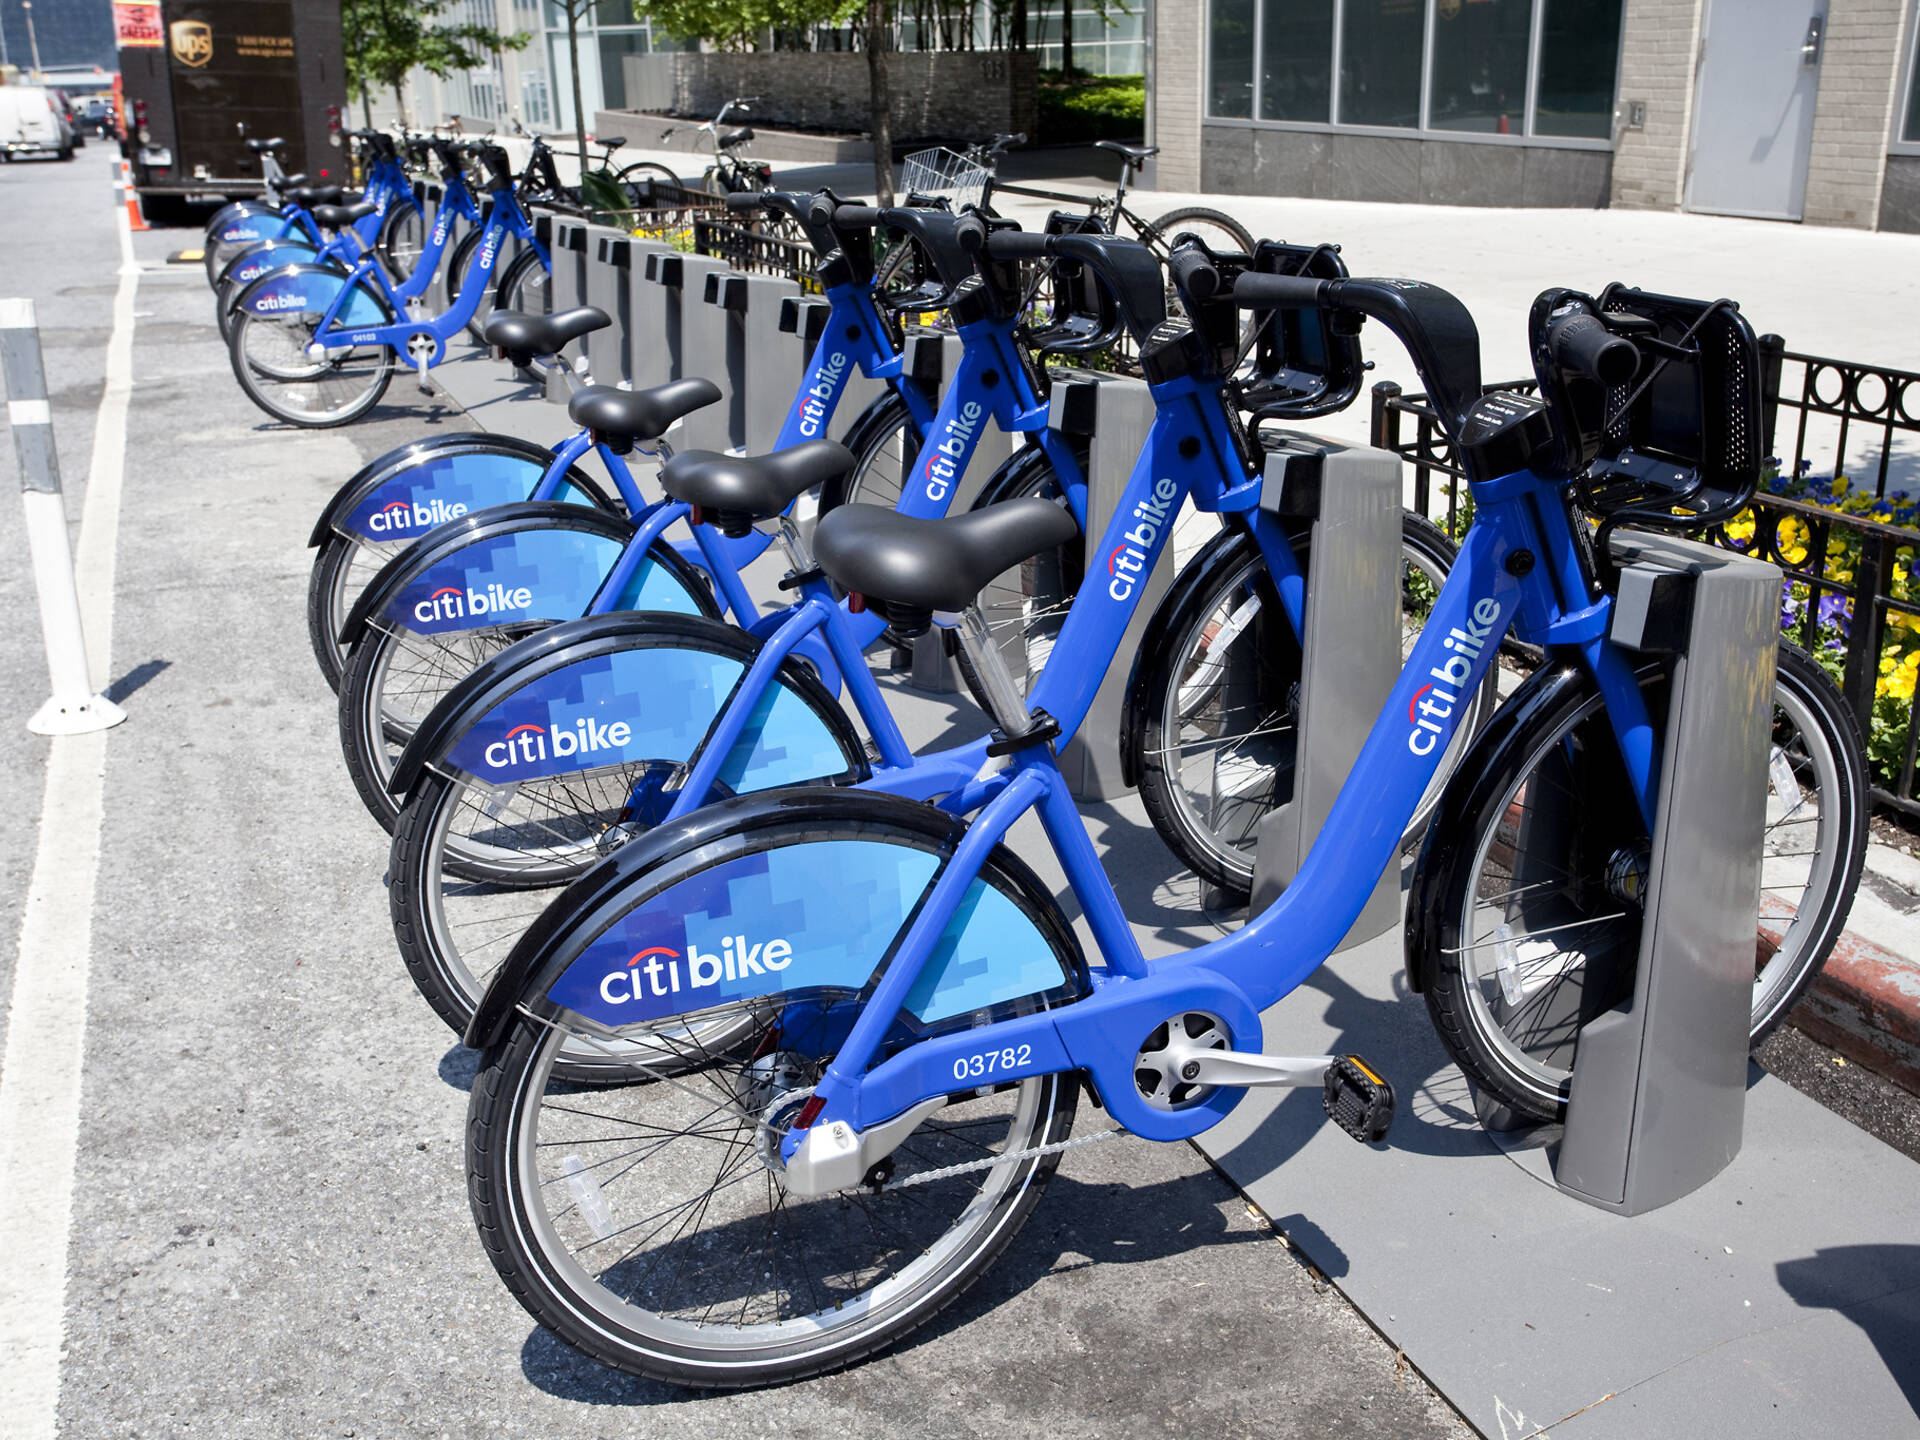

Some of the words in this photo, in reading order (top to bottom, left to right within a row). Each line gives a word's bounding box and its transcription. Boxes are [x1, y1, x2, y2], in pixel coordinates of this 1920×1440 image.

[178, 35, 209, 60] ups
[256, 294, 278, 310] citi
[278, 294, 307, 308] bike
[809, 352, 847, 400] bike
[799, 397, 826, 437] citi
[938, 401, 982, 459] bike
[926, 454, 957, 501] citi
[369, 502, 411, 531] citi
[413, 500, 468, 526] bike
[1124, 478, 1177, 549] bike
[1109, 544, 1146, 601] citi
[414, 587, 464, 623] citi
[467, 584, 532, 615] bike
[1430, 597, 1501, 688] bike
[485, 724, 546, 768] citi
[550, 718, 631, 757] bike
[1409, 683, 1457, 756] citi
[600, 947, 680, 1005] citi
[687, 934, 793, 990] bike
[952, 1043, 1032, 1080] 03782
